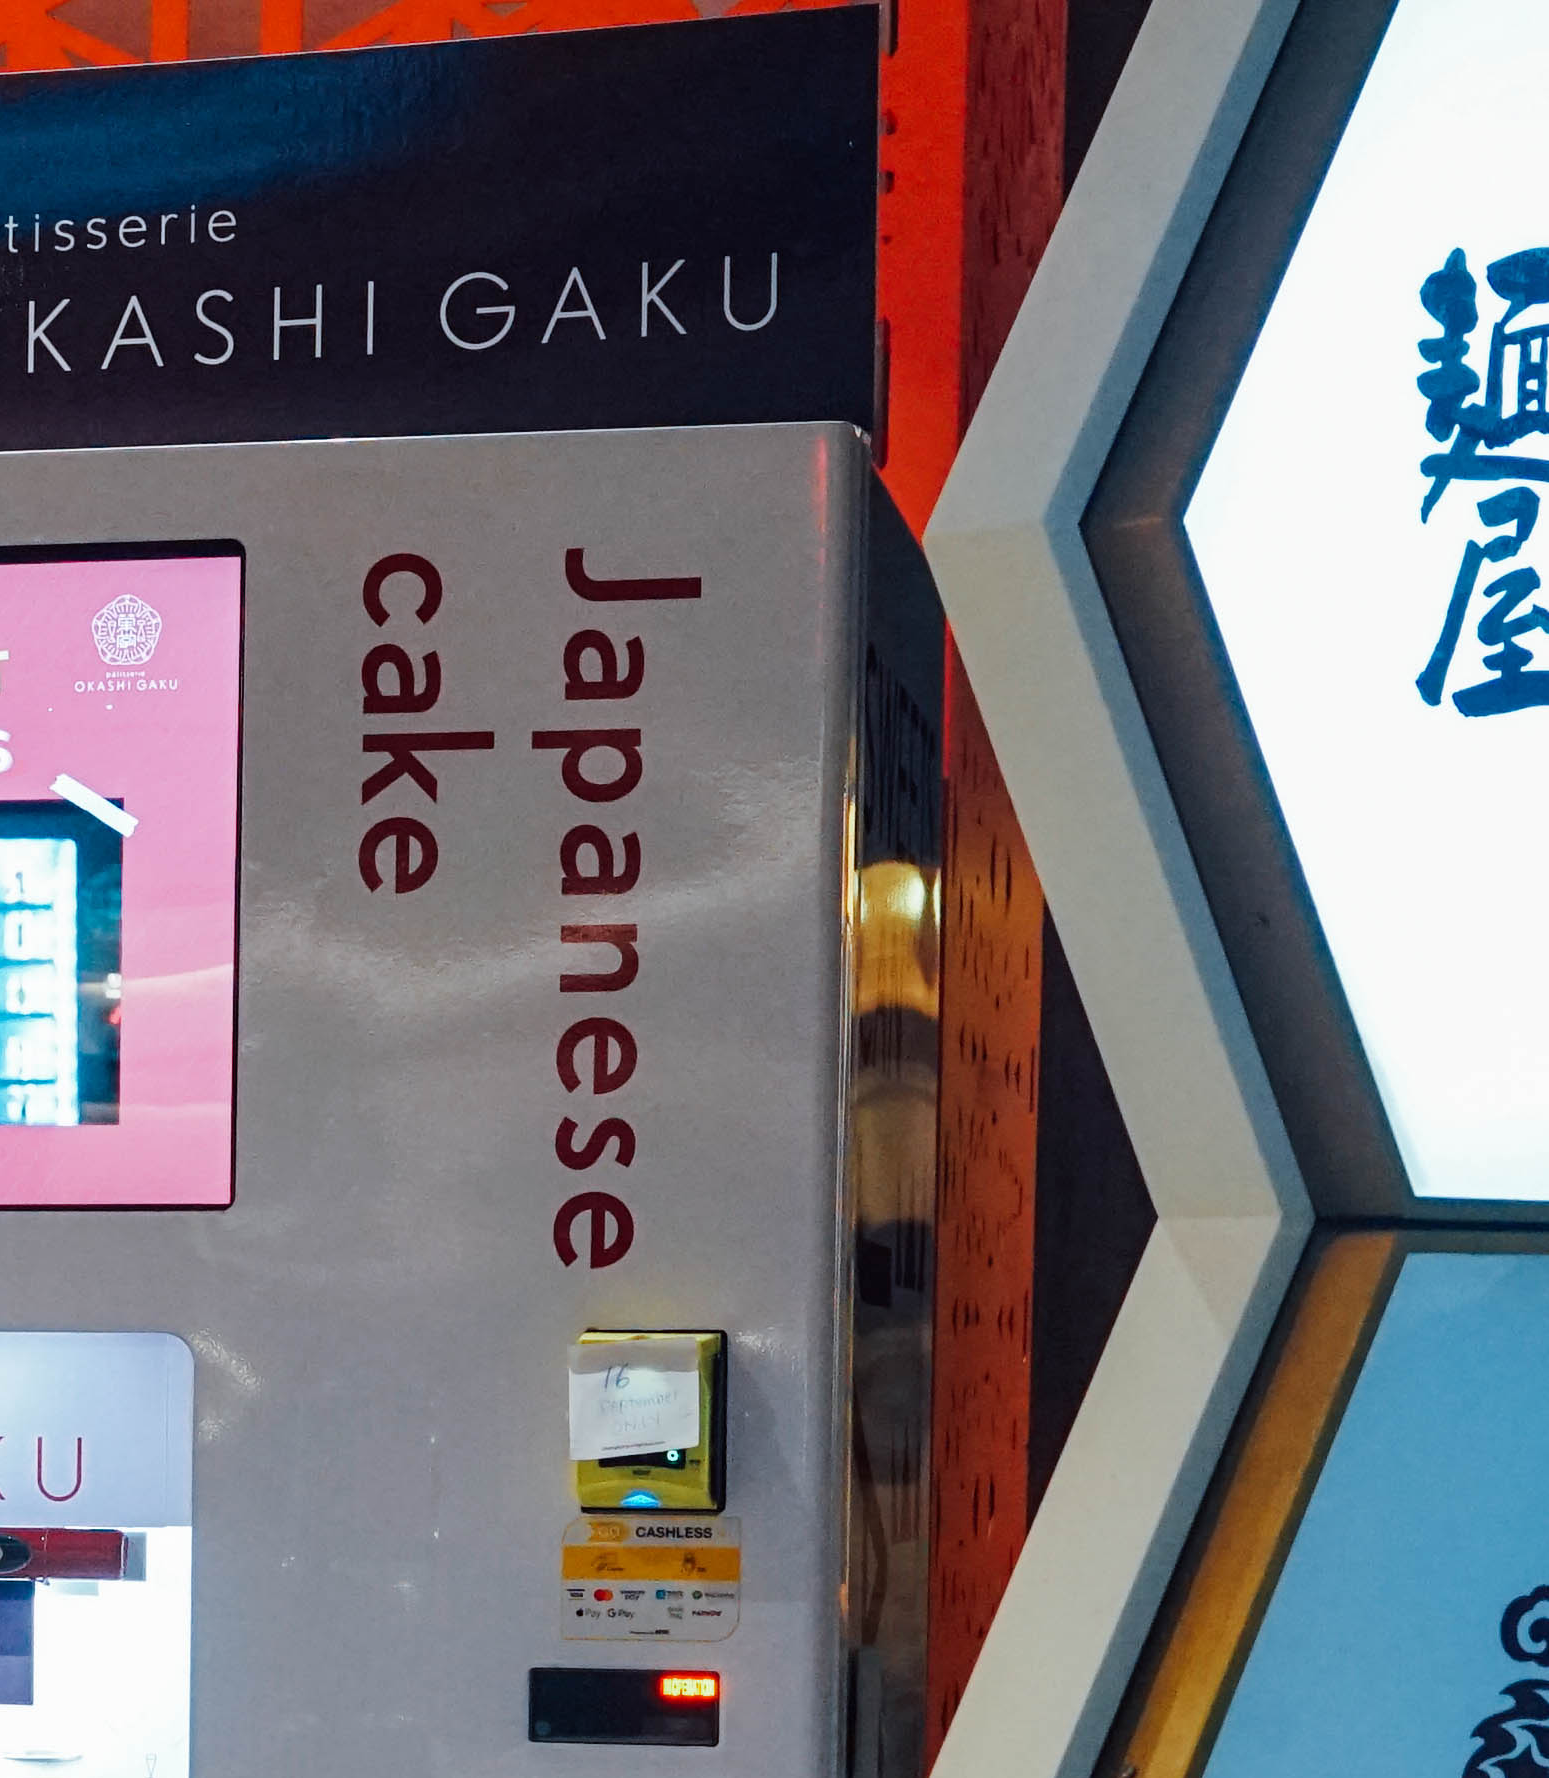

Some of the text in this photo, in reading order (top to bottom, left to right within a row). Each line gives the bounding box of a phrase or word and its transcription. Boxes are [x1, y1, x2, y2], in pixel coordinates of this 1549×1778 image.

[438, 252, 781, 352] GAKU
[74, 679, 178, 692] OKASHI GAKU
[358, 552, 495, 895] cake
[531, 547, 702, 1269] Japanese
[635, 1527, 713, 1539] CASHLESS
